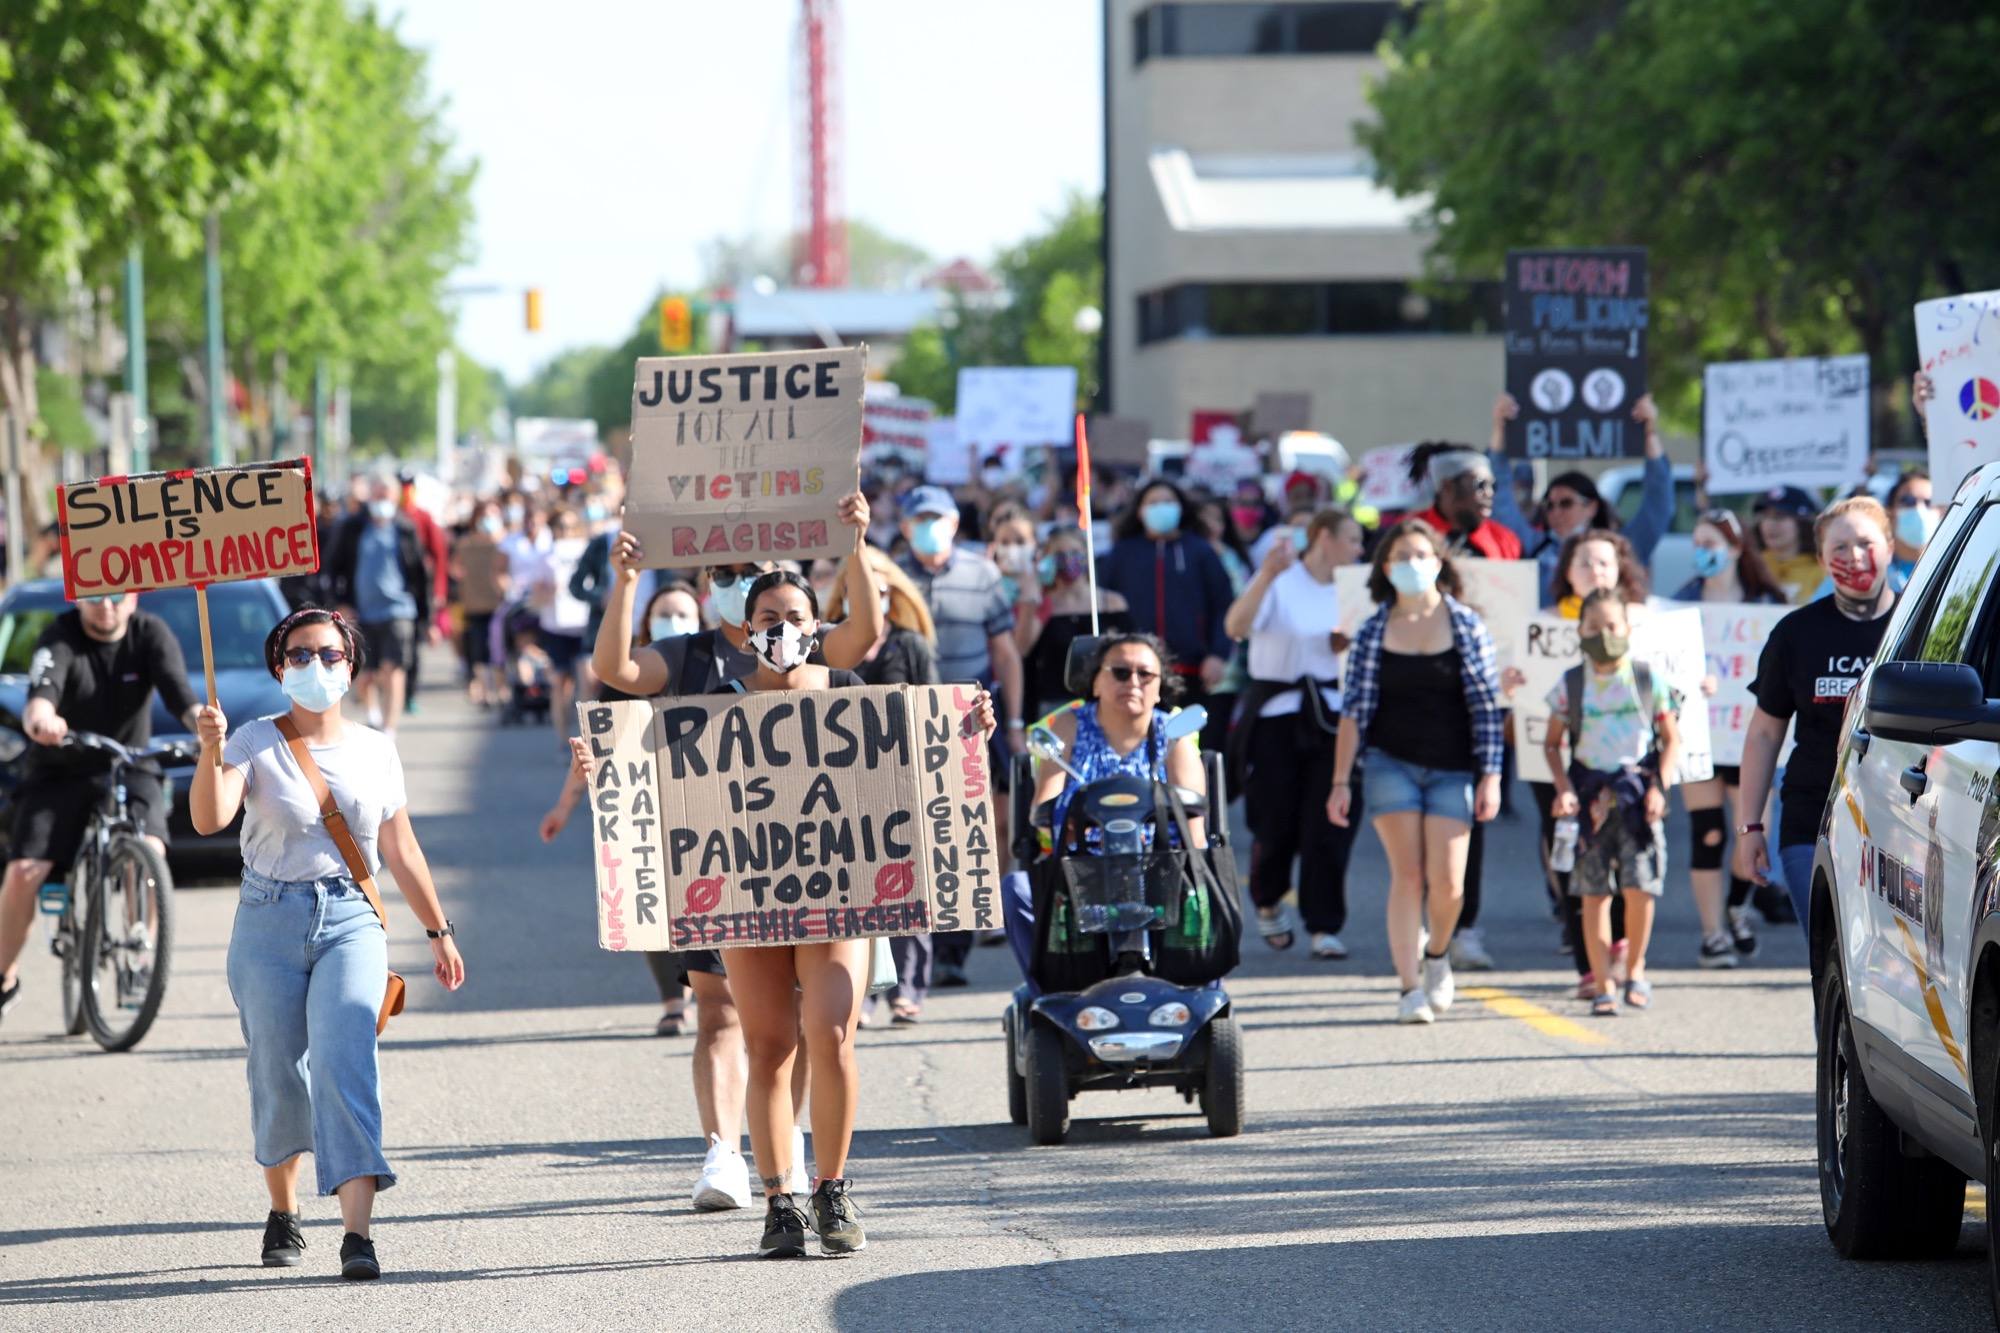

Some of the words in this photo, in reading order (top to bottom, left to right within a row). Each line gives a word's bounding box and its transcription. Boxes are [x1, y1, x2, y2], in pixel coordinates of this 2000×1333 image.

[639, 361, 840, 407] JUSTICE
[676, 407, 734, 446] FOR
[743, 405, 804, 441] ALL
[712, 443, 765, 470] THE
[67, 472, 283, 530] SILENCE
[667, 467, 824, 501] VICTIMS
[165, 516, 201, 539] IS
[724, 502, 757, 523] OF
[71, 522, 314, 588] COMPLIANCE
[672, 519, 829, 557] RACISM
[1817, 680, 1850, 695] BRE
[1836, 656, 1872, 673] CA
[663, 691, 910, 780] RACISM
[953, 686, 987, 799] LIVES
[588, 707, 620, 842] BLACK
[728, 776, 776, 814] IS
[800, 772, 842, 816] A
[1967, 770, 1990, 804] P102
[925, 688, 960, 931] INDIGENOUS
[628, 760, 659, 925] MATTER
[669, 809, 912, 876] PANDEMIC
[961, 802, 1001, 929] MATTER
[601, 844, 628, 950] LIVES
[740, 867, 850, 908] TOO!
[1878, 847, 1924, 928] POLICE
[673, 905, 809, 947] SYSTEMIC
[826, 899, 928, 938] RACISM
